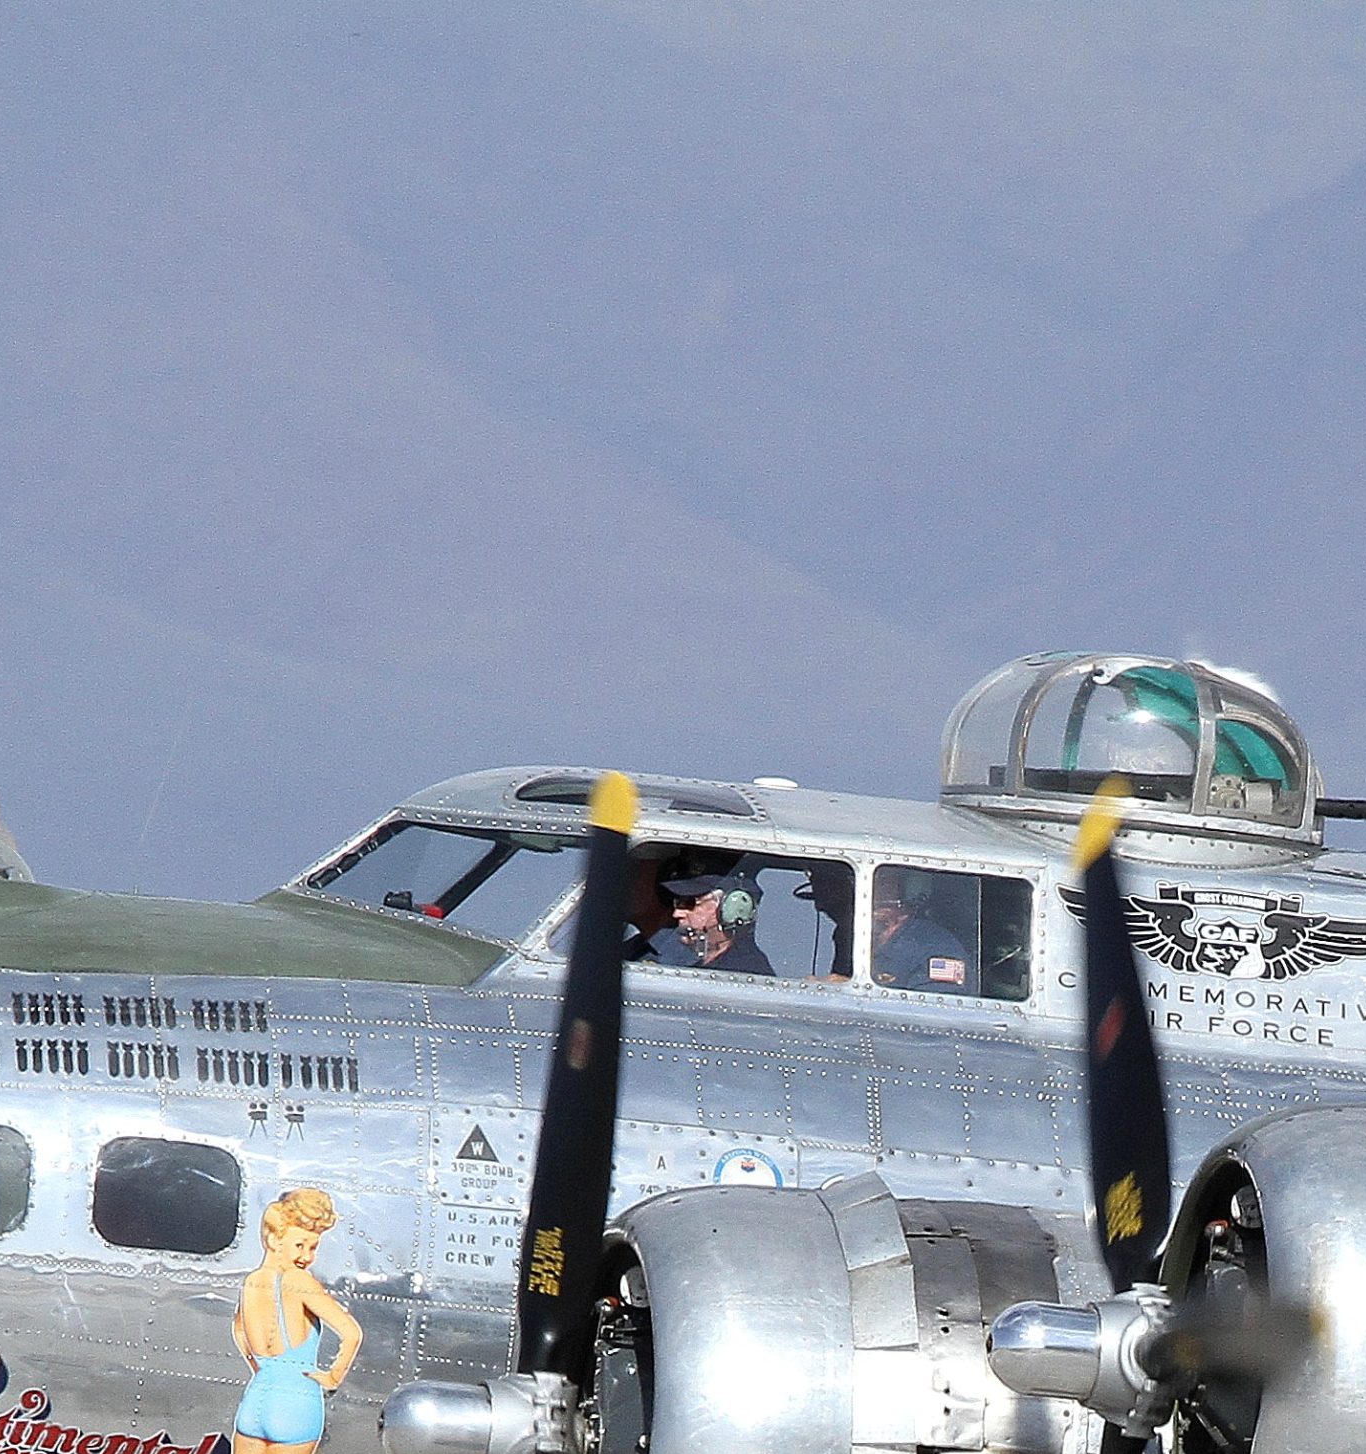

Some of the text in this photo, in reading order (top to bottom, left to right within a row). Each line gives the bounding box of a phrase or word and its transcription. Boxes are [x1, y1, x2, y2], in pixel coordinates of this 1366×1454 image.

[1200, 924, 1256, 942] CAF
[1149, 1009, 1334, 1047] IR FORCE
[471, 1141, 484, 1156] W
[656, 1155, 667, 1170] A
[484, 1165, 514, 1178] BOMB
[460, 1177, 498, 1190] GROUP
[447, 1232, 476, 1245] AIR
[445, 1252, 496, 1267] CREW
